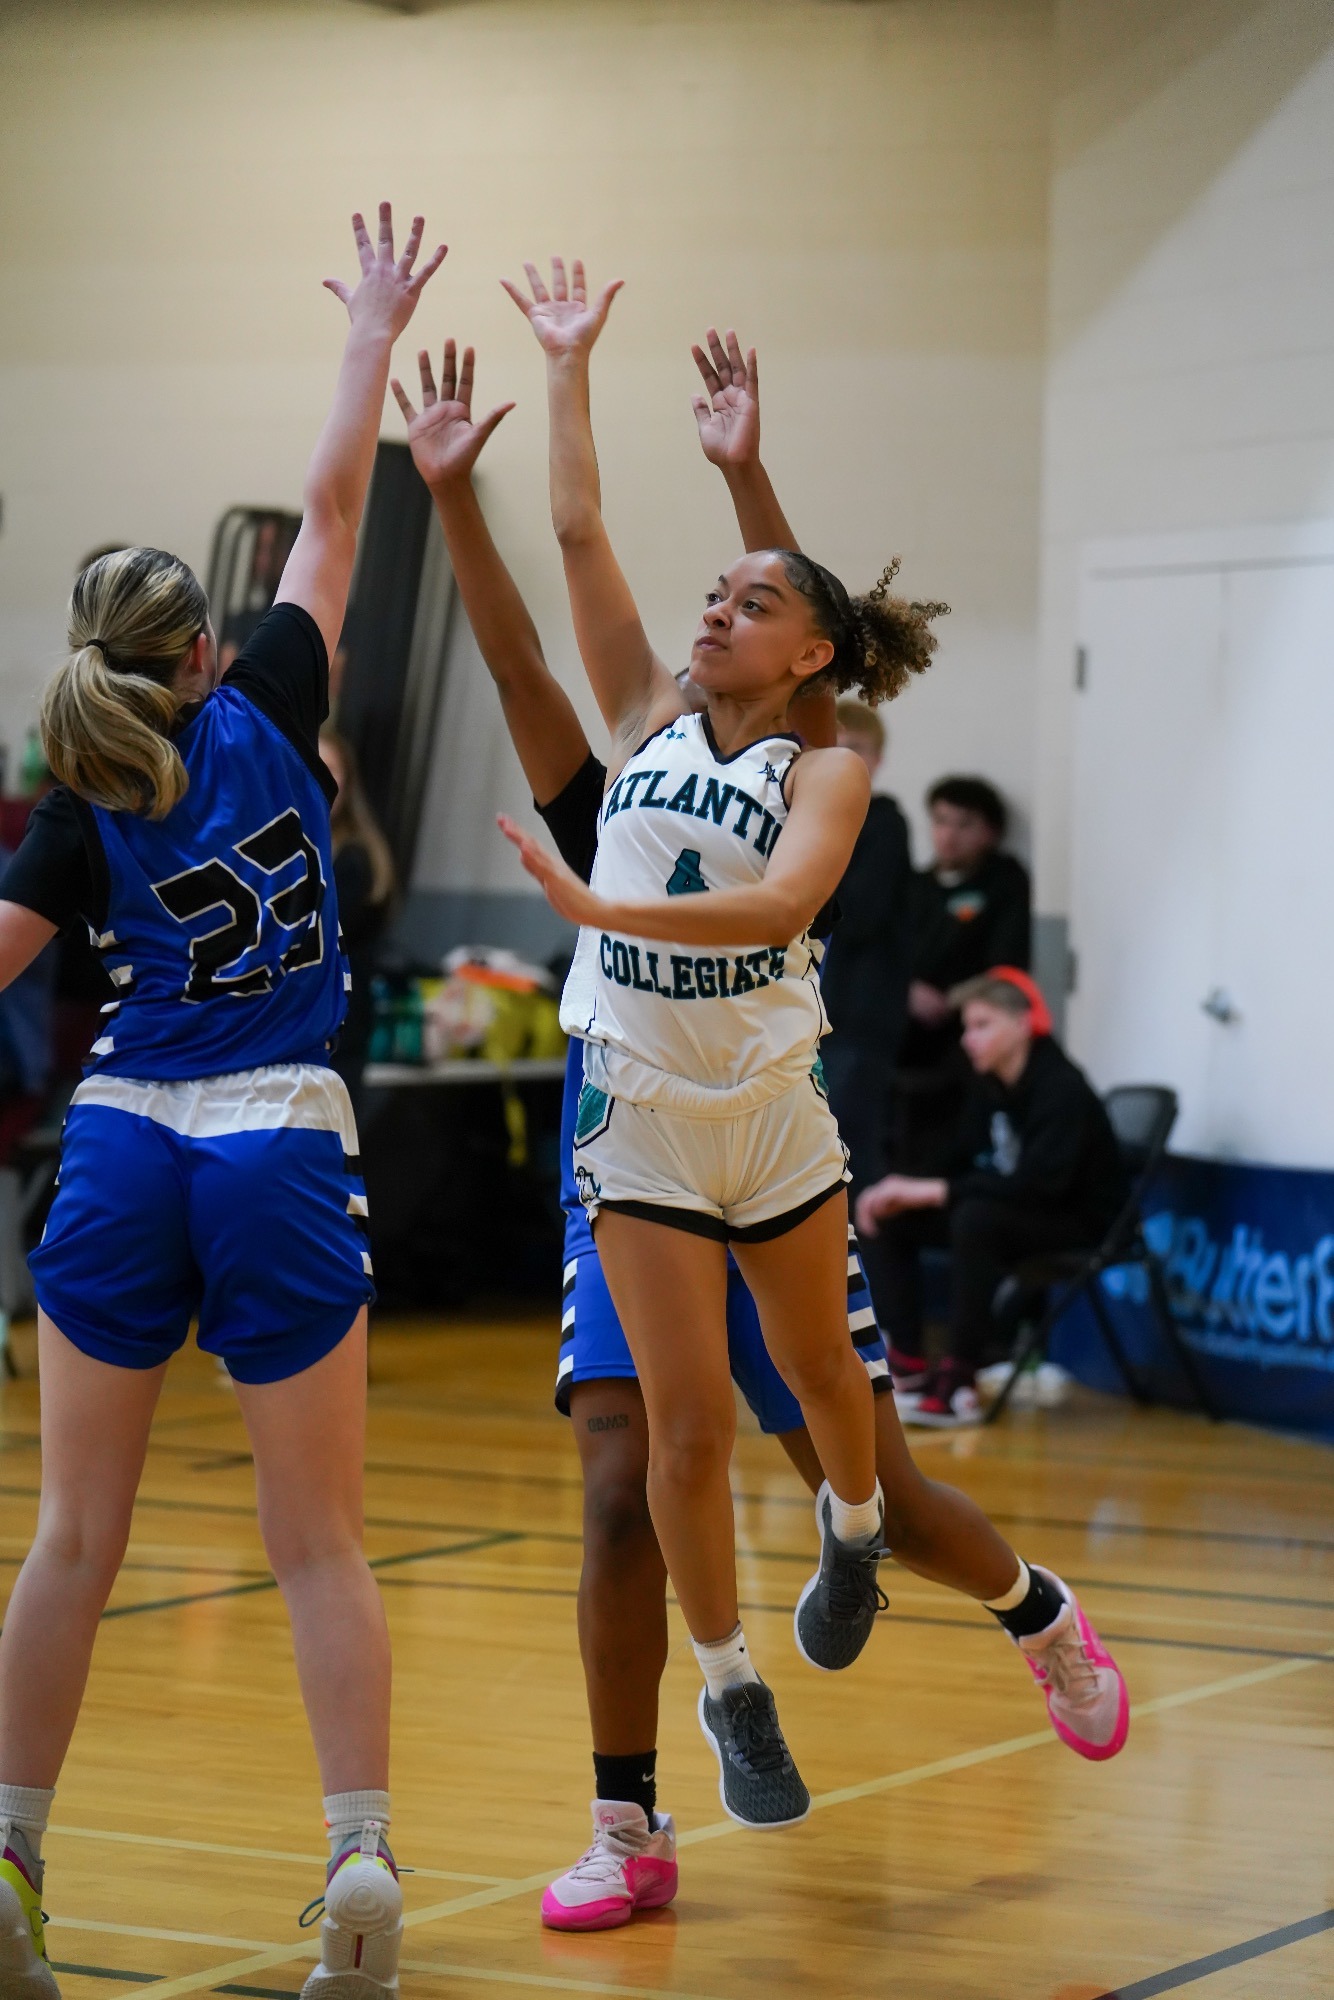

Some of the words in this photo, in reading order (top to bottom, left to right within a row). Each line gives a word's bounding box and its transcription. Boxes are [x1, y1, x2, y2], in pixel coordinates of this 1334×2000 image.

[150, 806, 327, 1005] 23
[665, 848, 710, 898] 4
[600, 932, 788, 1001] COLLEGIATE
